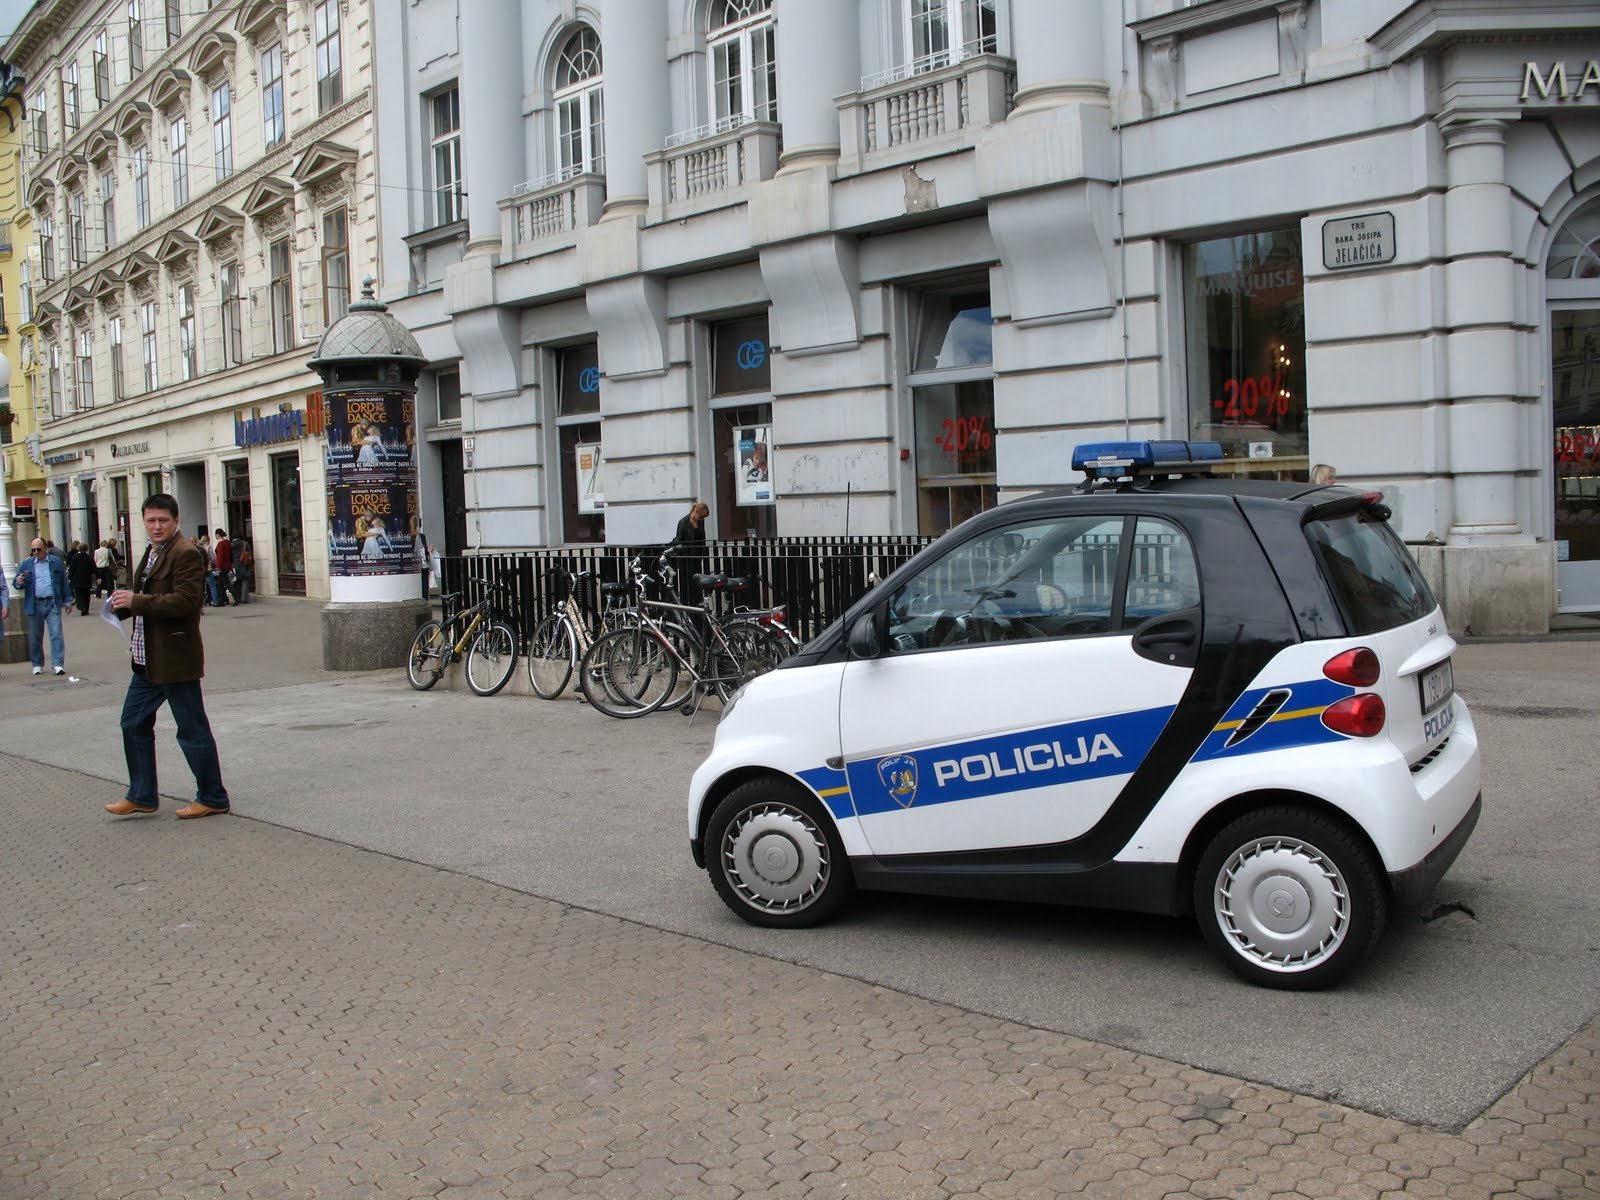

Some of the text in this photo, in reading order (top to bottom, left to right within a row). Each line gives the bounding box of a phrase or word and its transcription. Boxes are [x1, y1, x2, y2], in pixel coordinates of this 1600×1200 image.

[1519, 60, 1600, 99] MA
[1335, 231, 1382, 244] BANA JOSIPA
[1351, 222, 1365, 231] TRG
[1335, 242, 1382, 264] JELAČIĆA
[1199, 269, 1297, 297] MARQUISE
[1213, 373, 1289, 418] -20%
[347, 402, 375, 414] LORD
[347, 412, 388, 424] DANCE
[935, 416, 991, 452] -20%
[351, 493, 379, 505] LORD
[351, 503, 391, 515] DANCE
[1424, 702, 1454, 743] POLICIJA
[932, 732, 1124, 788] POLICIJA
